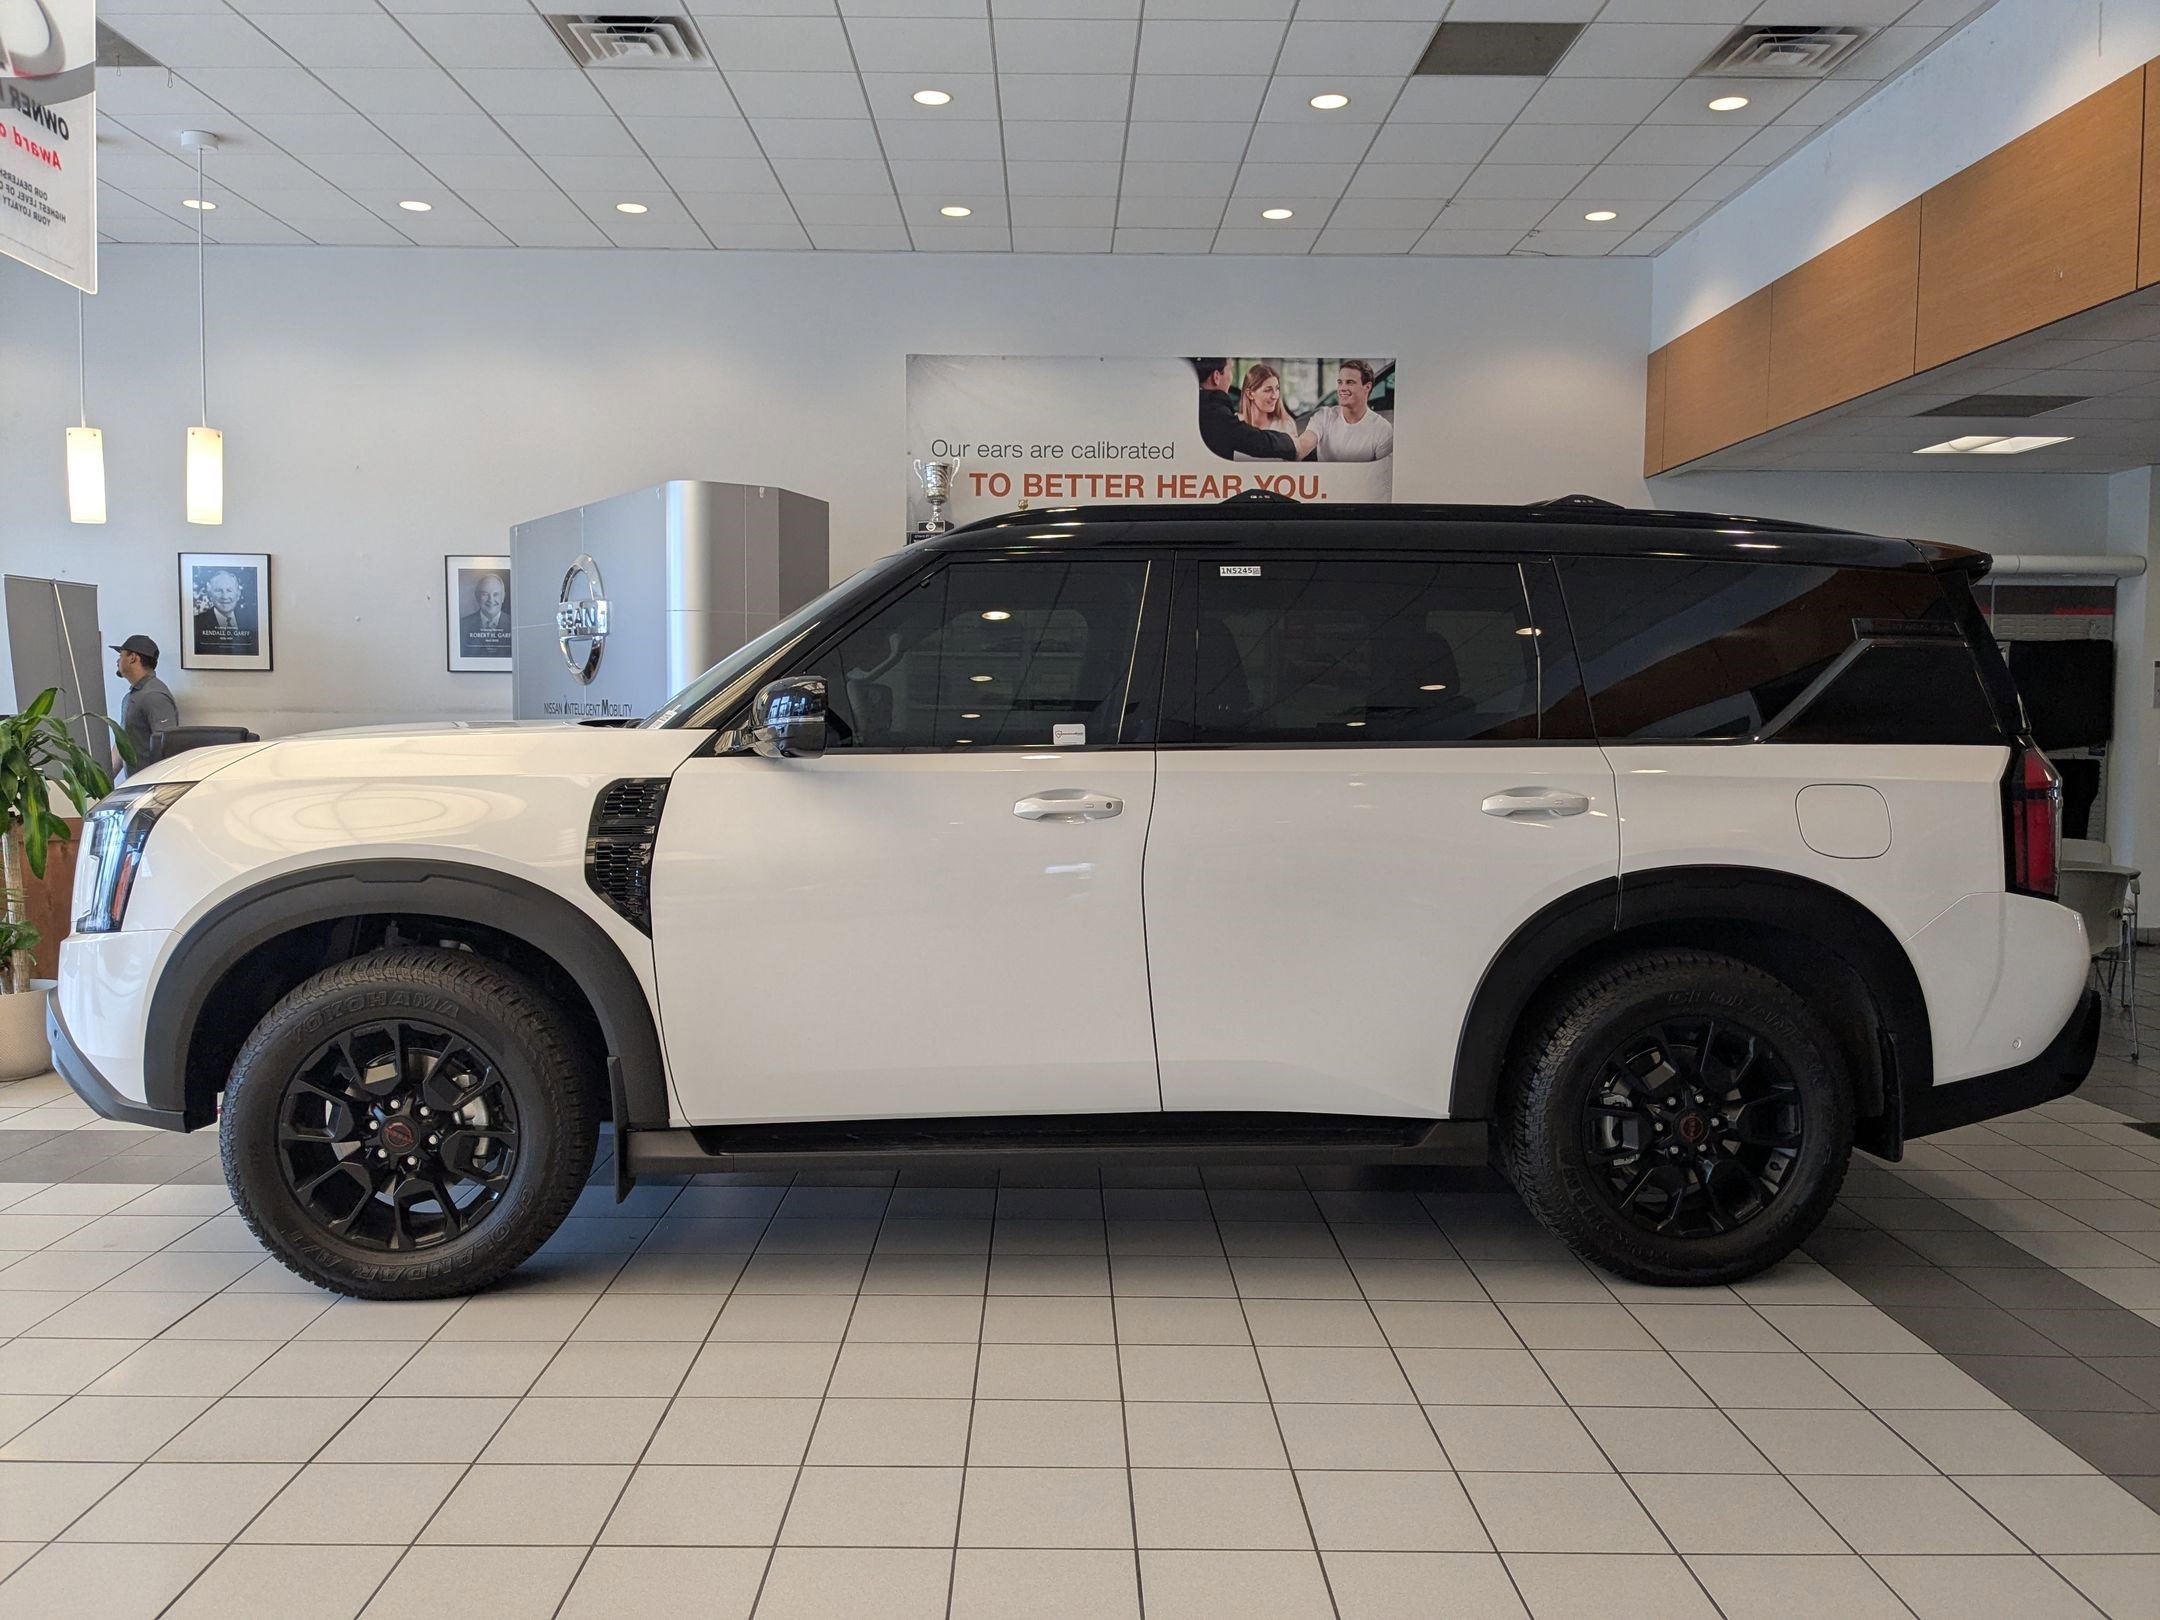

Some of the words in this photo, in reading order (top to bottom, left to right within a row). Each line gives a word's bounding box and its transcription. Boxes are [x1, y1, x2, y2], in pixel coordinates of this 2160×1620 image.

[931, 439, 970, 458] Our
[977, 444, 1023, 458] ears
[1030, 444, 1064, 458] are
[1071, 441, 1175, 459] calibrated
[969, 473, 1011, 497] TO
[1023, 473, 1145, 498] BETTER
[1157, 474, 1243, 498] HEAR
[1253, 475, 1327, 499] YOU.
[543, 702, 563, 714] NISSAN
[564, 698, 601, 716] INTELLIGENT
[601, 699, 633, 717] MOBILITY
